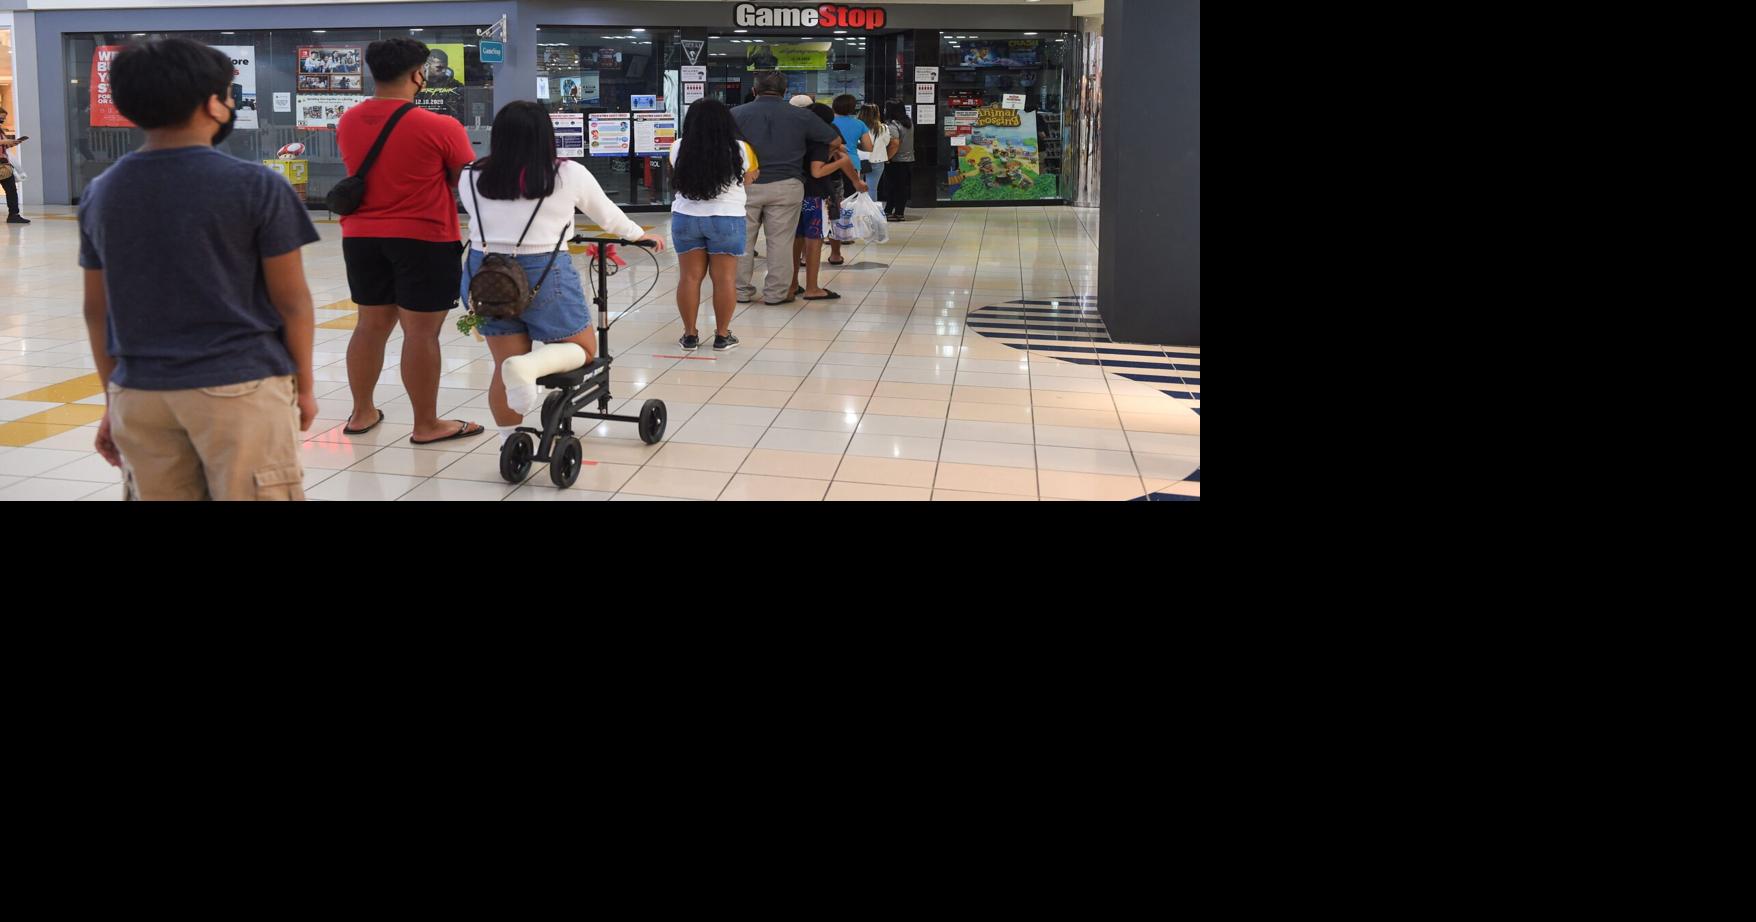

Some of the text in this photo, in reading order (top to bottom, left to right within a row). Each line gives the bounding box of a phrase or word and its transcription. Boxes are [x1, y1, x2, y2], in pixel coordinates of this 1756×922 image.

[736, 3, 885, 30] GameStop
[230, 57, 249, 66] ore
[977, 116, 1020, 126] rossing
